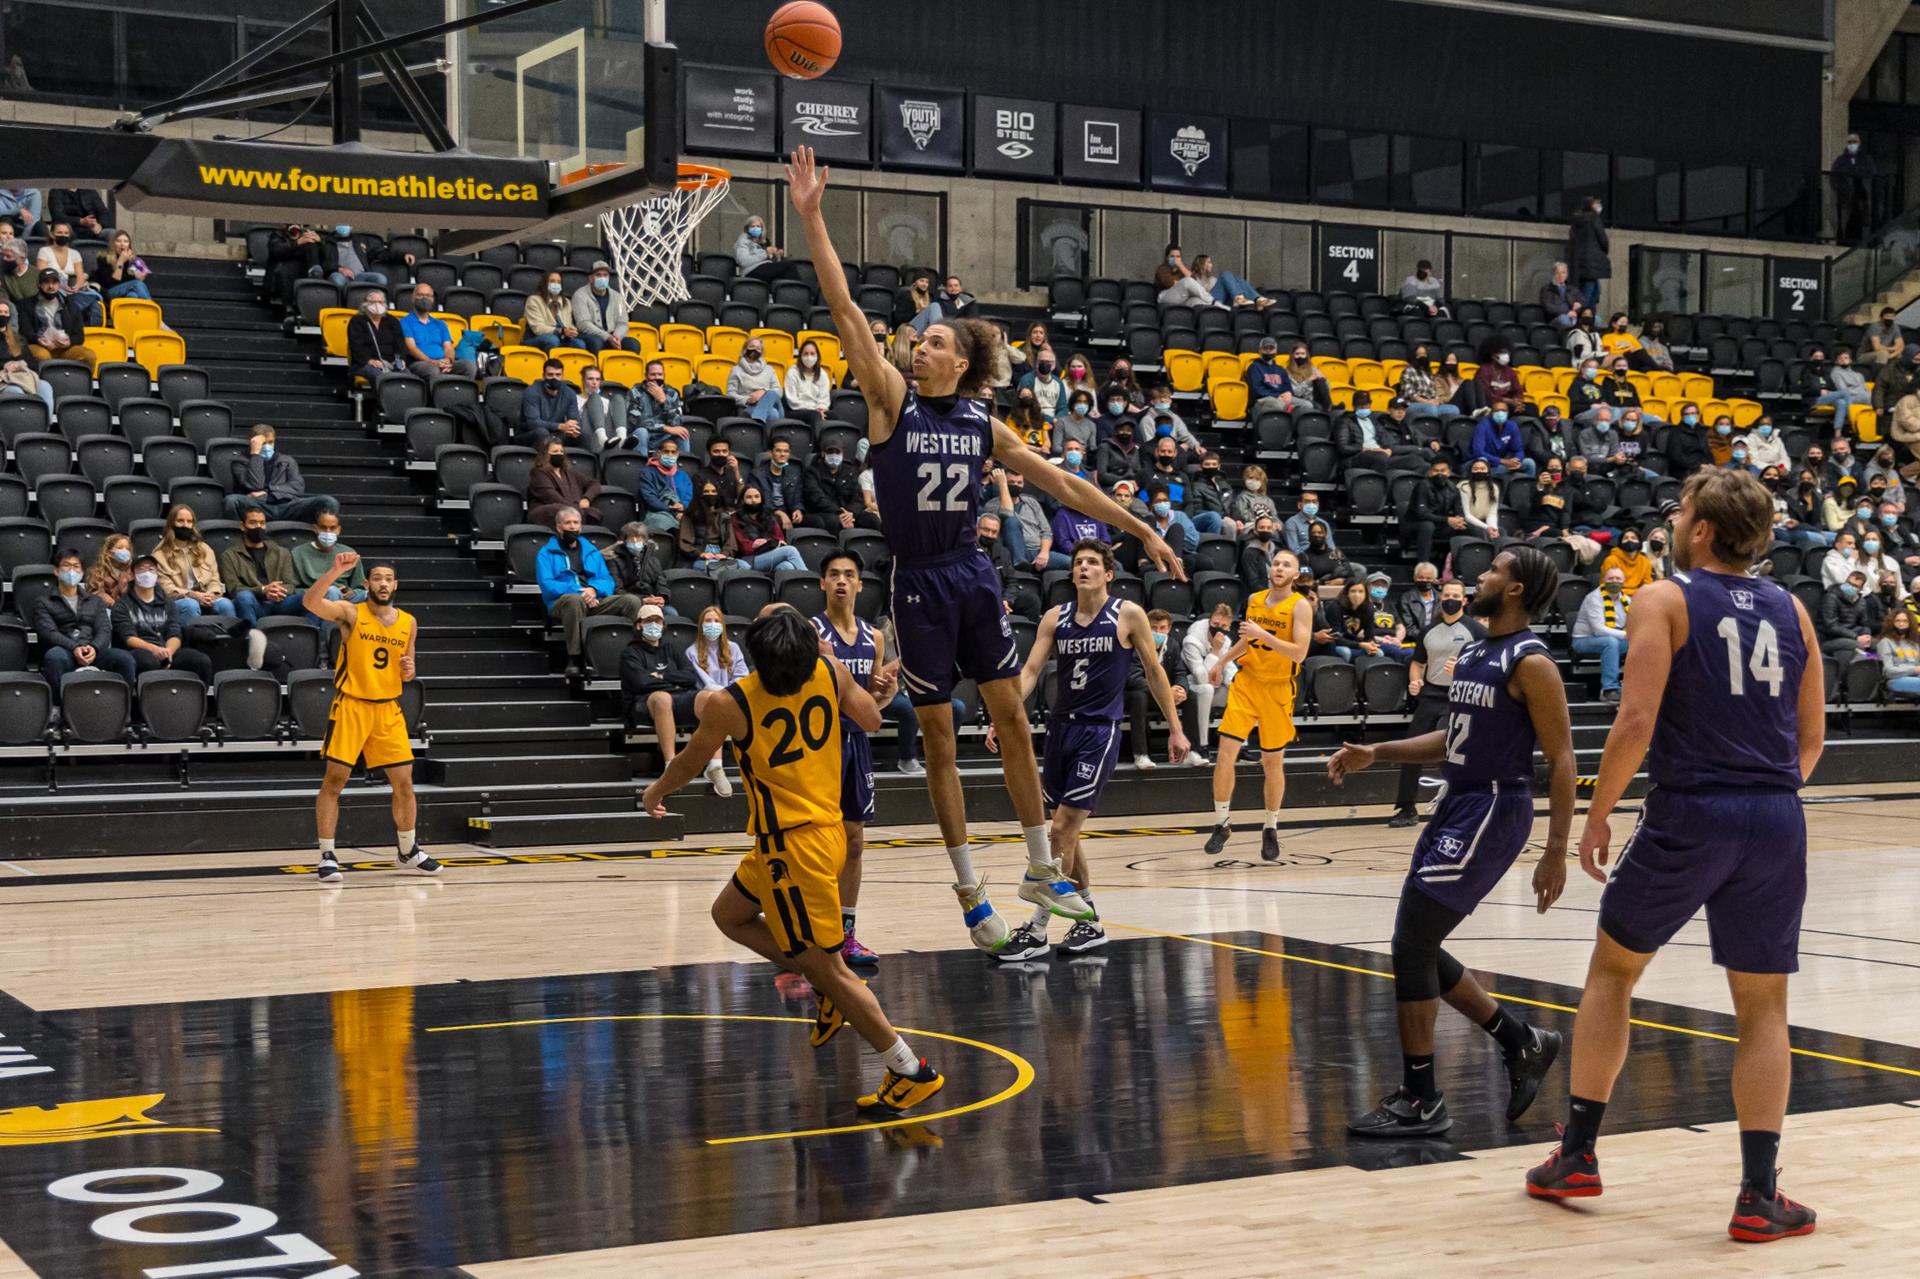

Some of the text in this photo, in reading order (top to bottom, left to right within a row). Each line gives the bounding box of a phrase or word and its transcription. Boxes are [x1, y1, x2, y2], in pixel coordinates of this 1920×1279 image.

[796, 102, 859, 119] CHERREY
[904, 107, 938, 128] YOUTH
[996, 109, 1035, 131] BIO
[996, 128, 1035, 141] STEEL
[200, 164, 539, 202] www.forumathletic.ca
[1328, 244, 1375, 260] SECTION
[1342, 259, 1360, 283] 4
[1779, 276, 1819, 290] SECTION
[1791, 289, 1805, 311] 2
[906, 431, 982, 457] WESTERN
[917, 462, 970, 512] 22
[360, 633, 405, 648] WARRIORS
[1057, 636, 1113, 655] WESTERN
[373, 647, 389, 670] 9
[1716, 616, 1784, 697] 14
[1070, 658, 1090, 690] 5
[1448, 680, 1496, 709] ESTERN
[760, 694, 834, 769] 20
